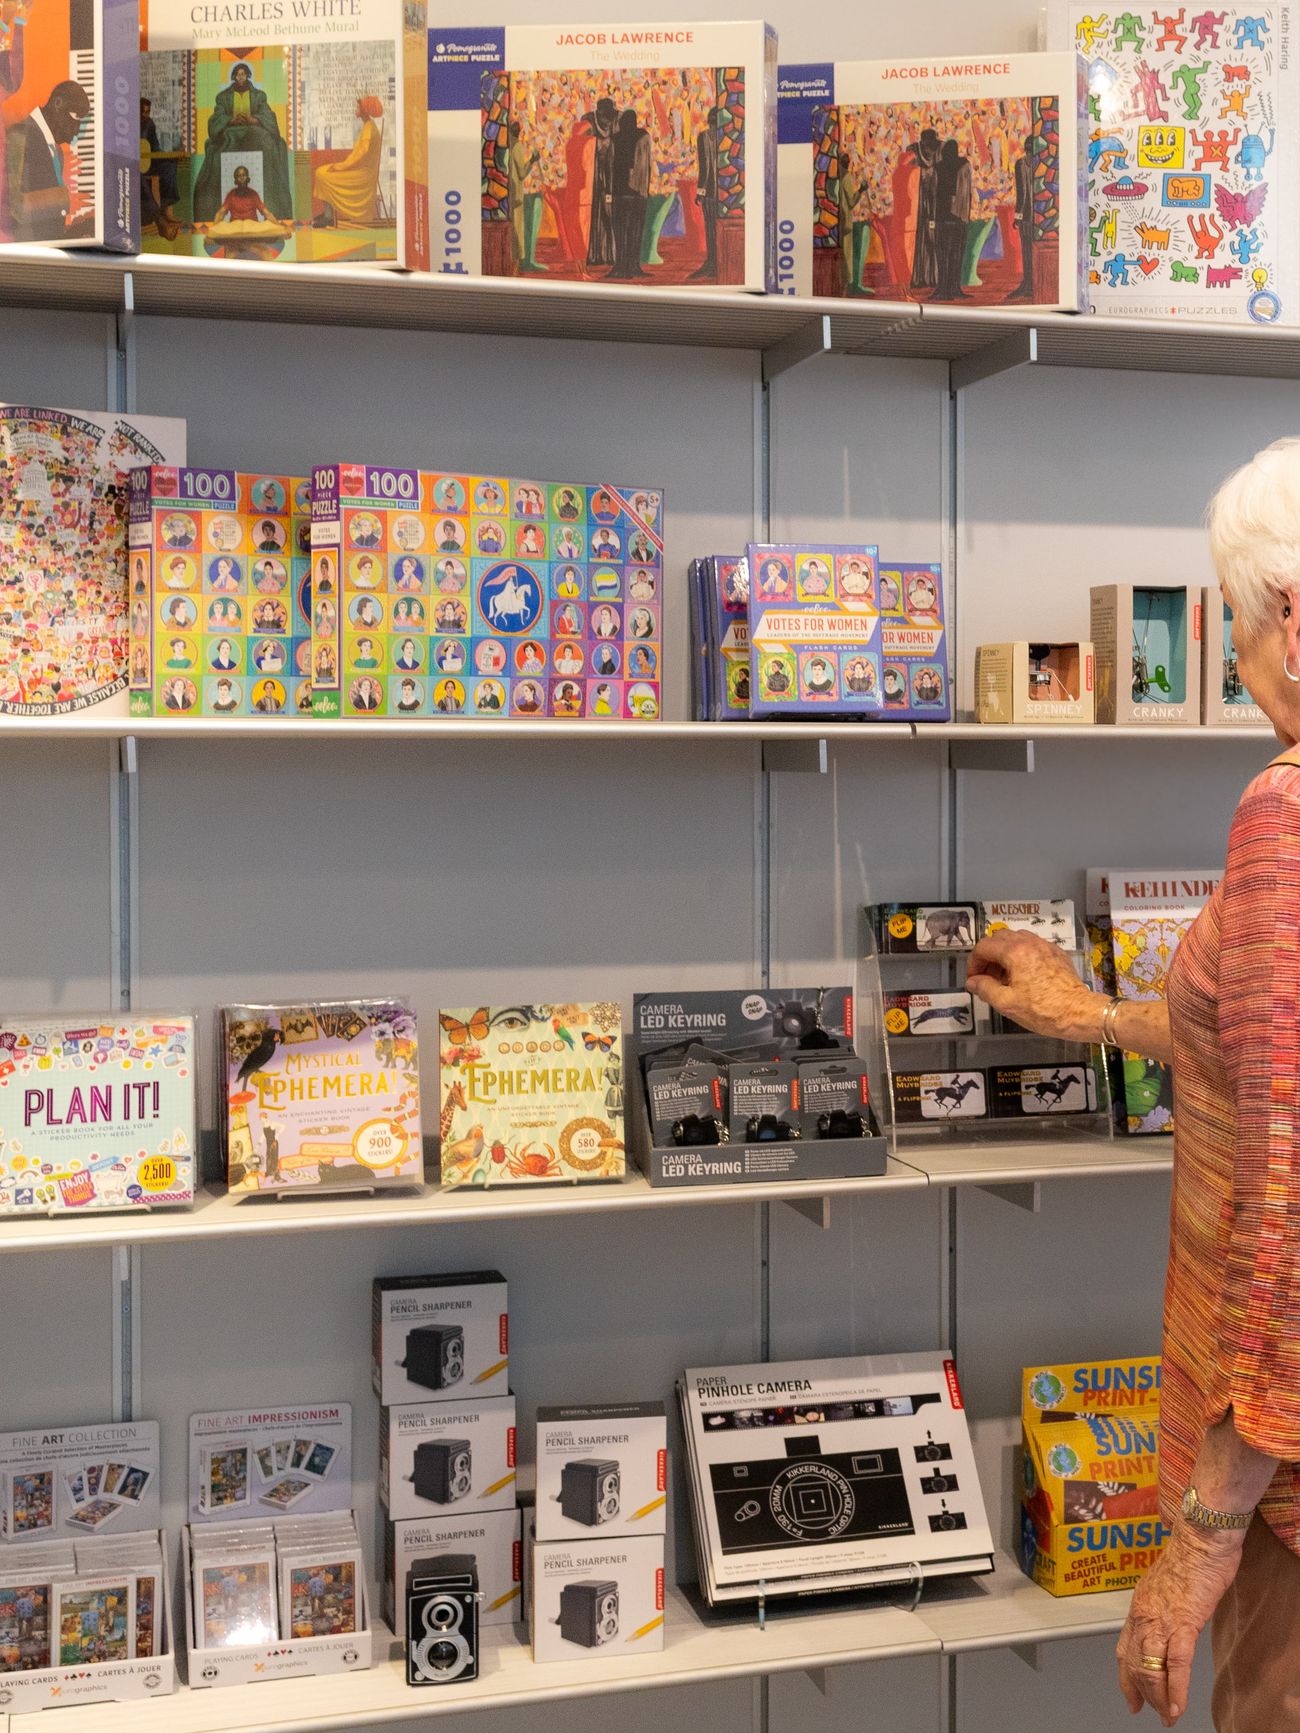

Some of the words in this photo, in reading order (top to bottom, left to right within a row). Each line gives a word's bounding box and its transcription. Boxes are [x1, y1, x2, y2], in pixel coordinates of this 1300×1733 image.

[190, 2, 284, 23] CHARLES
[293, 0, 362, 17] WHITE
[1280, 6, 1291, 37] Keith
[192, 28, 222, 40] Mary
[226, 25, 270, 38] McLeod
[274, 22, 321, 35] Bethune
[325, 20, 360, 32] Mural
[555, 32, 607, 46] JACOB
[611, 31, 694, 45] LAWRENCE
[432, 54, 470, 63] ARTPIECE
[471, 53, 501, 62] PUZZLE
[591, 50, 611, 61] The
[613, 49, 661, 63] Wedding
[1279, 38, 1290, 71] Haring
[881, 67, 929, 80] JACOB
[933, 63, 1011, 77] LAWRENCE
[802, 89, 830, 97] PUZZLE
[444, 190, 462, 257] 1000
[778, 219, 795, 283] 1000
[1177, 306, 1238, 315] PUZZLES
[14, 408, 31, 419] ARE
[71, 416, 88, 431] WE
[116, 421, 134, 437] NOT
[131, 470, 148, 491] 100
[183, 472, 231, 499] 100
[314, 469, 335, 490] 100
[369, 471, 415, 498] 100
[129, 501, 150, 517] PUZZLE
[214, 502, 236, 510] PUZZLE
[312, 499, 338, 517] PUZZLE
[766, 618, 801, 631] VOTES
[804, 618, 825, 631] FOR
[827, 619, 868, 631] WOMEN
[897, 631, 934, 644] WOMEN
[88, 678, 127, 707] BECAUSE
[55, 701, 73, 714] ARE
[74, 695, 90, 709] WE
[1025, 703, 1083, 715] SPINNEY
[1132, 706, 1184, 719] CRANKY
[1223, 707, 1264, 719] CRANK
[892, 917, 907, 928] FLIP
[896, 926, 907, 934] ME
[640, 1004, 684, 1016] CAMERA
[640, 1015, 665, 1029] LED
[668, 1013, 727, 1028] KEYRING
[887, 1010, 901, 1026] FLIP
[895, 1019, 906, 1031] ME
[286, 1051, 362, 1075] MYSTICAL
[460, 1062, 603, 1105] EPHEMERA!
[652, 1082, 682, 1092] CAMERA
[733, 1078, 762, 1086] CAMERA
[803, 1077, 831, 1085] CAMERA
[803, 1085, 820, 1094] LED
[821, 1081, 858, 1093] KEYRING
[250, 1071, 398, 1111] EPHEMERA!
[654, 1091, 672, 1100] LED
[673, 1085, 710, 1098] KEYRING
[733, 1086, 749, 1095] LED
[751, 1084, 788, 1094] KEYRING
[24, 1085, 113, 1127] PLAN
[123, 1081, 160, 1120] IT!
[290, 1109, 338, 1118] ENCHANTING
[339, 1106, 371, 1115] VINTAGE
[39, 1128, 71, 1136] STICKER
[73, 1126, 96, 1134] BOOK
[49, 1133, 108, 1142] PRODUCTIVITY
[369, 1136, 392, 1149] 900
[577, 1138, 595, 1148] 580
[662, 1154, 703, 1165] CAMERA
[143, 1163, 172, 1182] 2,500
[662, 1166, 684, 1177] LED
[688, 1162, 742, 1176] KEYRING
[60, 1171, 90, 1190] ENJOY
[390, 1298, 417, 1306] CAMERA
[390, 1304, 420, 1314] PENCIL
[422, 1300, 472, 1312] SHARPENER
[696, 1376, 728, 1388] PAPER
[697, 1383, 755, 1400] PINHOLE
[757, 1379, 813, 1395] CAMERA
[197, 1418, 222, 1428] FINE
[224, 1415, 245, 1426] ART
[248, 1408, 340, 1424] IMPRESSIONISM
[398, 1418, 428, 1429] PENCIL
[430, 1414, 480, 1426] SHARPENER
[12, 1436, 38, 1448] FINE
[41, 1434, 65, 1445] ART
[68, 1428, 137, 1443] COLLECTION
[545, 1437, 576, 1447] PENCIL
[578, 1434, 629, 1445] SHARPENER
[786, 1464, 839, 1482] KIKKERLAND
[1089, 1454, 1154, 1481] PRINT
[837, 1479, 849, 1495] PIN
[772, 1484, 783, 1513] 20MM
[843, 1494, 853, 1515] HOLE
[403, 1528, 431, 1537] CAMERA
[828, 1515, 850, 1536] OPTIC
[403, 1535, 433, 1545] PENCIL
[435, 1528, 486, 1541] SHARPENER
[544, 1554, 571, 1562] CAMERA
[544, 1560, 574, 1570] PENCIL
[577, 1554, 627, 1567] SHARPENER
[1071, 1553, 1108, 1570] CREATE
[1064, 1561, 1117, 1583] BEAUTIFUL
[1082, 1576, 1102, 1589] ART
[204, 1655, 234, 1665] PLAYING
[235, 1653, 258, 1662] CARDS
[97, 1668, 126, 1677] CARTES
[136, 1664, 162, 1673] JOUER
[32, 1676, 58, 1686] CARDS
